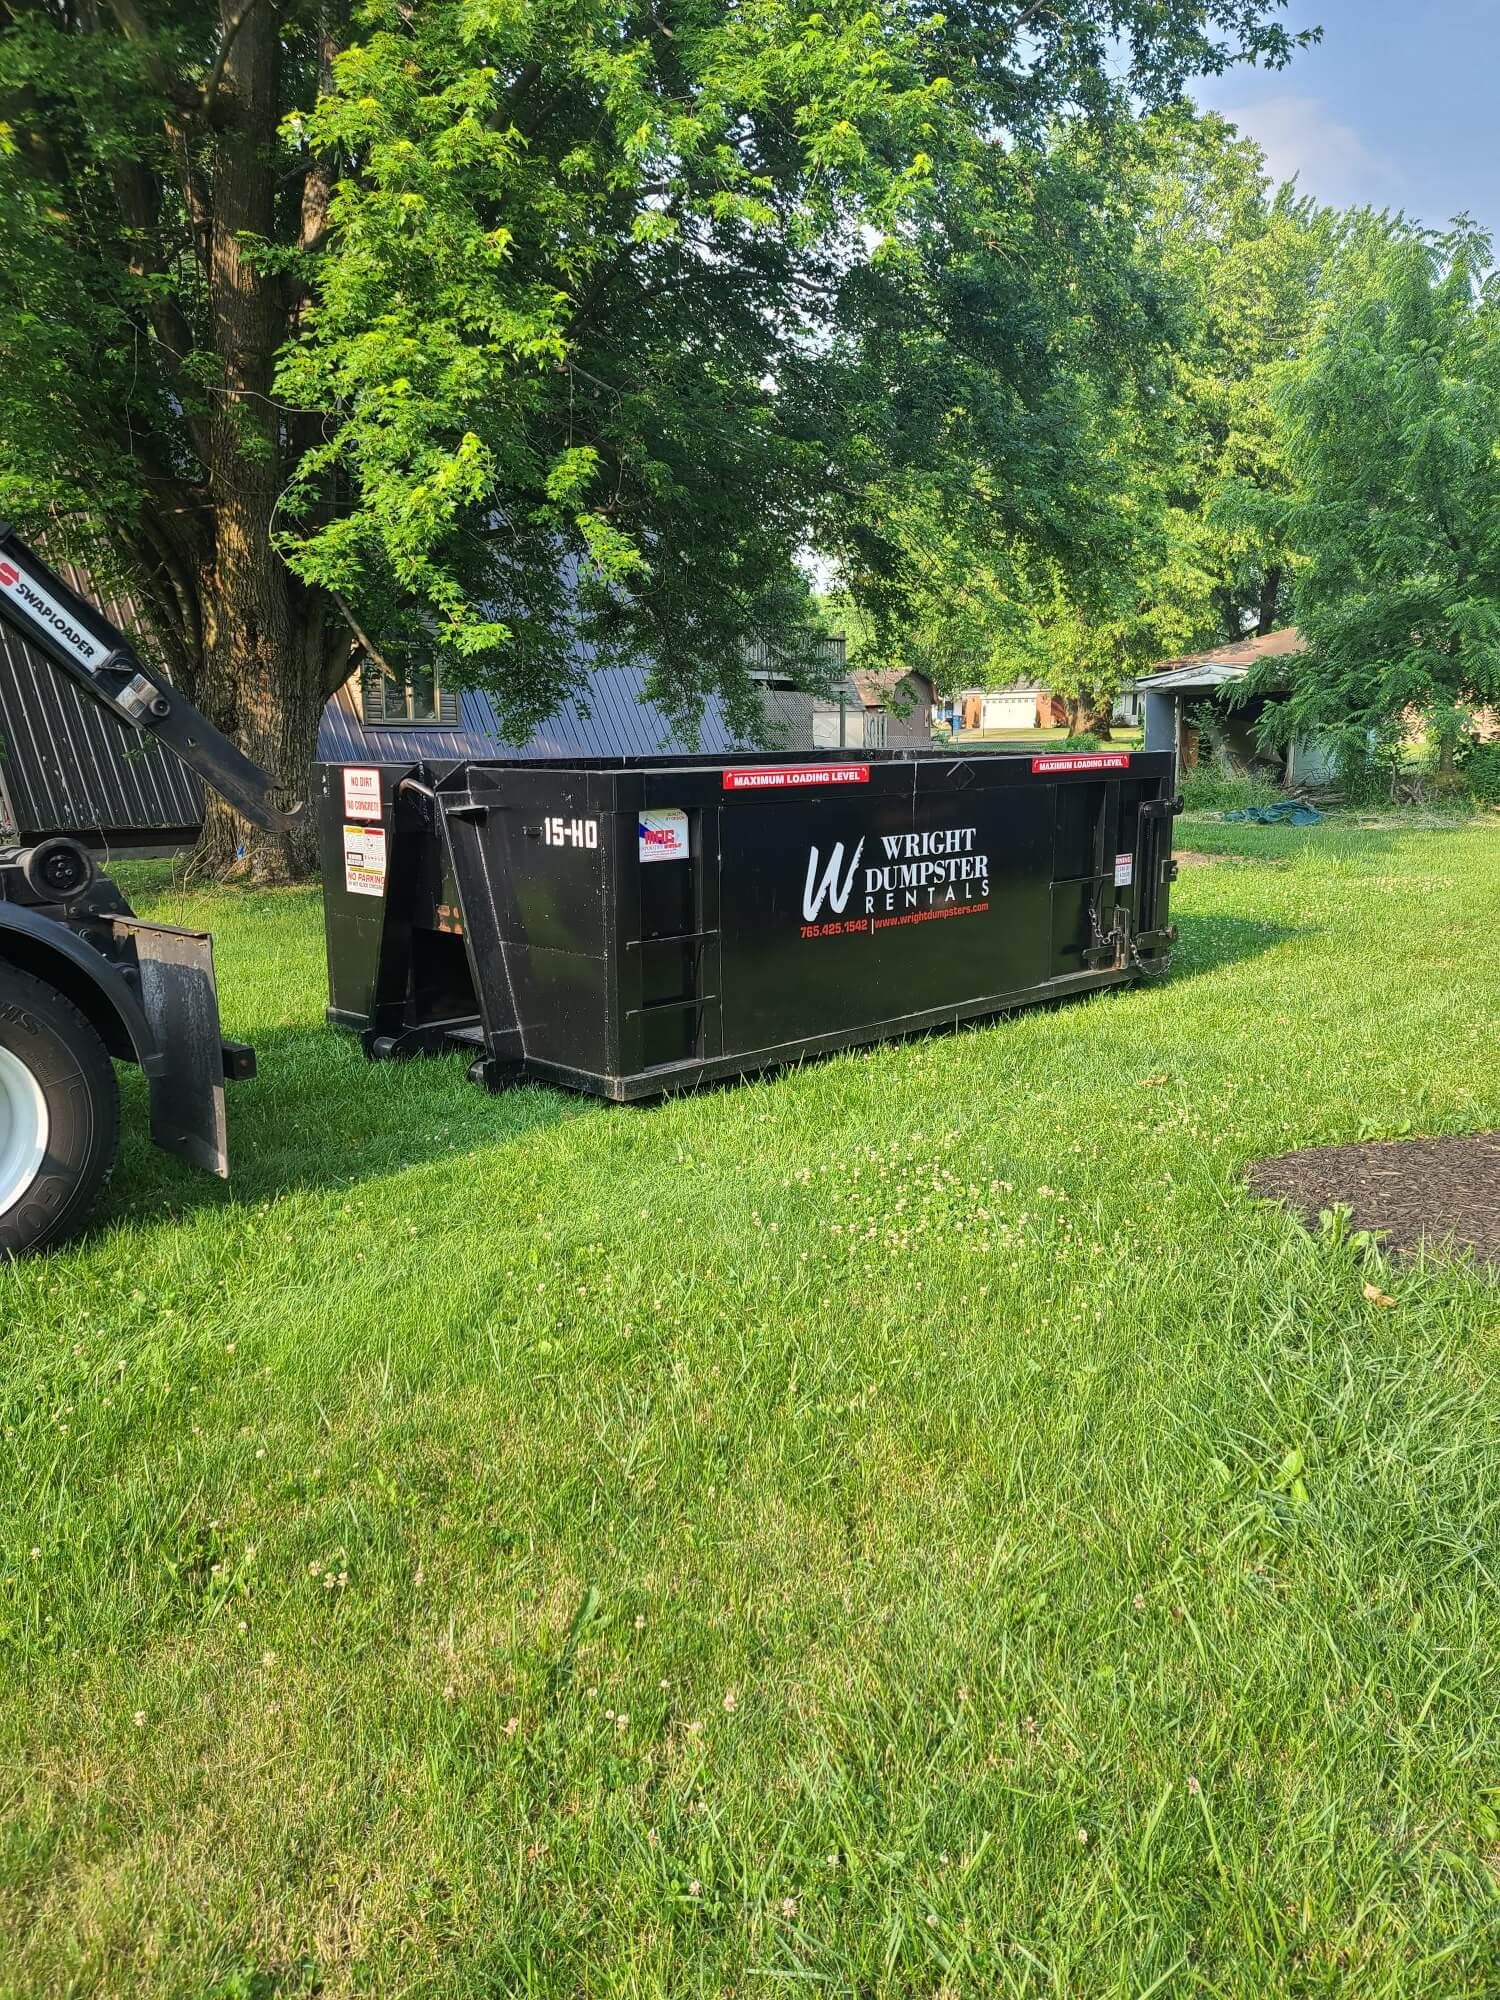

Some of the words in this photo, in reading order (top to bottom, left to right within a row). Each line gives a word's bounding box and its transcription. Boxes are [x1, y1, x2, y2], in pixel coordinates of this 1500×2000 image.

[16, 583, 95, 659] SWAPLOADER
[734, 775, 784, 786] MAXIMUM
[787, 773, 829, 784] LOADING
[831, 771, 860, 781] LEVEL
[1039, 762, 1073, 770] MAXIMUM
[1074, 760, 1103, 769] LOADING
[1104, 759, 1123, 767] LEVEL
[351, 776, 358, 786] NO
[360, 777, 372, 787] DIRT
[881, 828, 976, 860] WRIGHT
[348, 872, 356, 880] NO
[865, 856, 989, 892] DUMPSTER
[865, 880, 990, 913] RENTALS
[800, 919, 868, 938] 765.425.1542
[875, 902, 989, 928] www.wrightdumpsters.com
